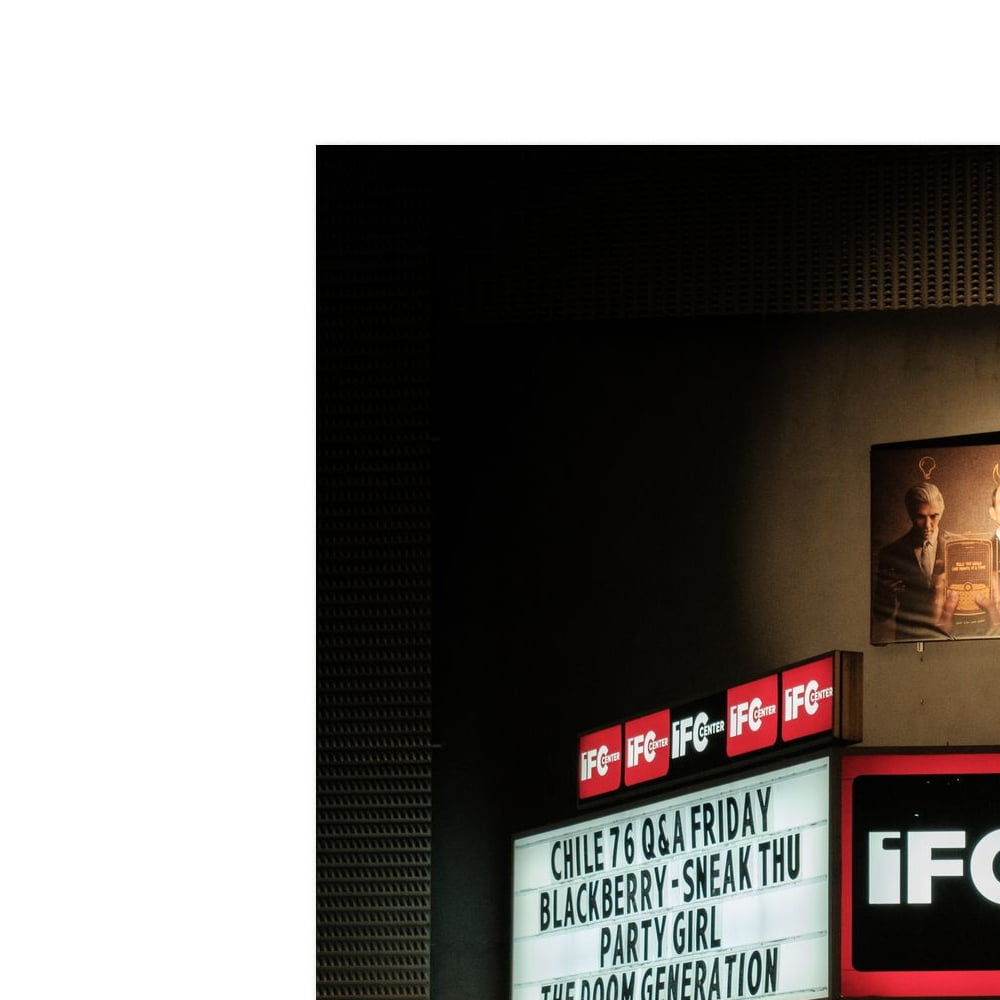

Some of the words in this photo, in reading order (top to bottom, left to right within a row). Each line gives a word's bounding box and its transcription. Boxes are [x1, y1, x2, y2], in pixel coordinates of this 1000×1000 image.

[809, 686, 833, 702] CENTER
[753, 704, 776, 719] CENTER
[698, 721, 725, 737] CENTER
[648, 736, 669, 751] CENTER
[600, 751, 620, 765] CENTER
[551, 831, 604, 881] CHILE
[641, 810, 685, 860] Q&A
[691, 786, 772, 849] FRIDAY
[758, 832, 801, 887] THU
[600, 914, 666, 968] PARTY
[673, 905, 721, 956] GIRL
